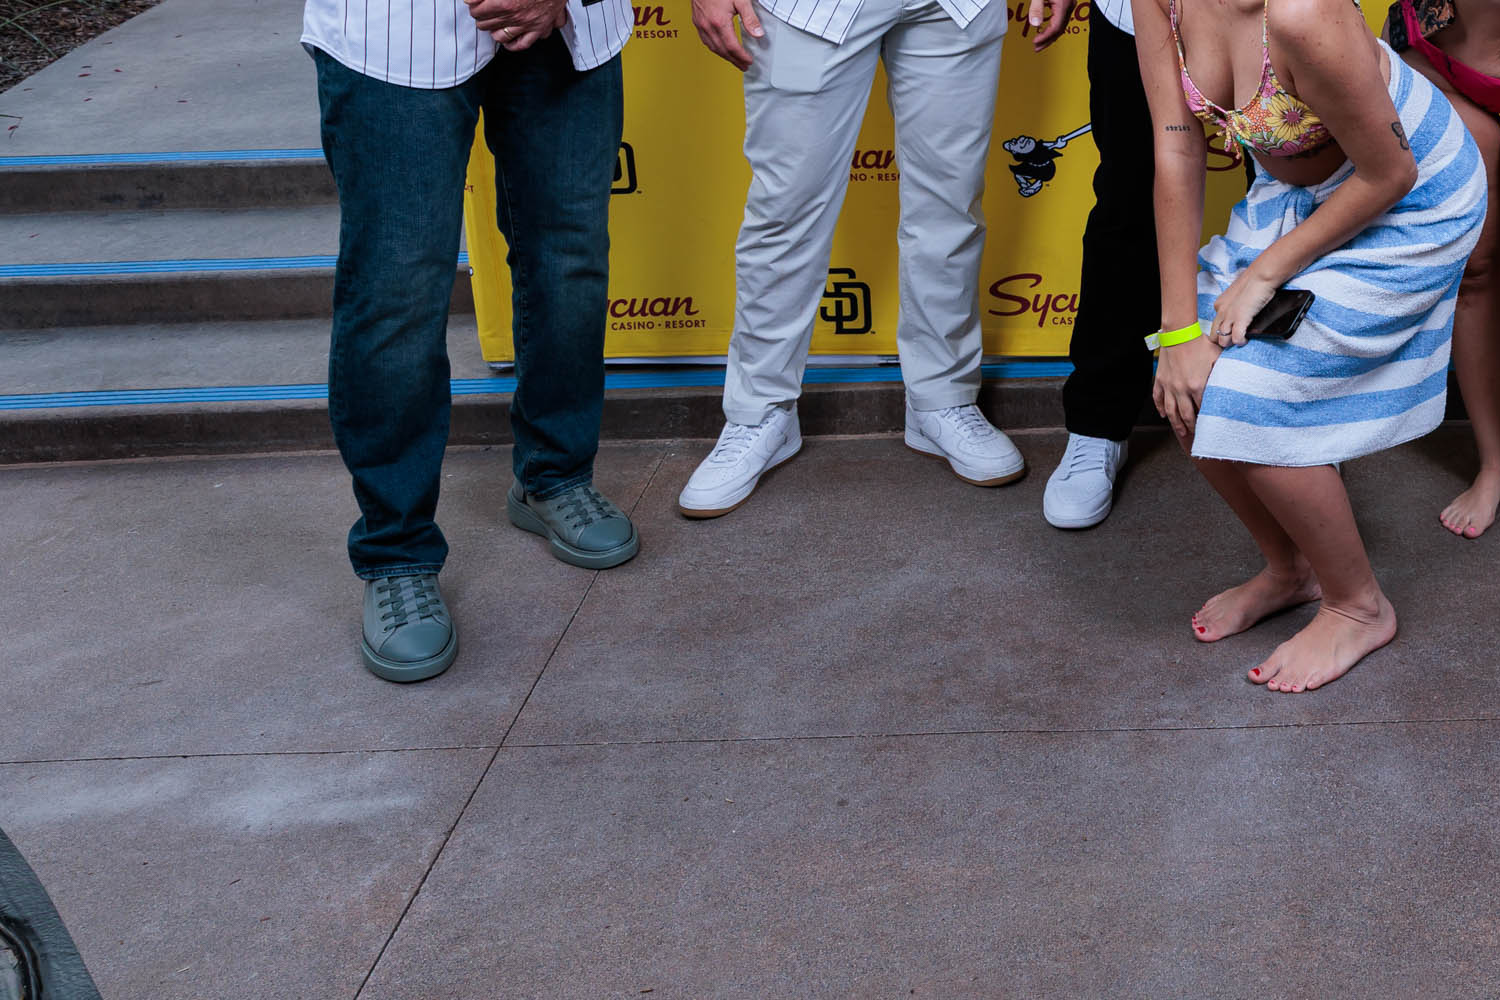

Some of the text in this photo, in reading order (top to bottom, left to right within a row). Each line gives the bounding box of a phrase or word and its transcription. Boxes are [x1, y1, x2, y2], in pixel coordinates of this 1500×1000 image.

[636, 30, 678, 39] RESORT
[877, 173, 900, 182] RES
[608, 296, 700, 319] cuan
[610, 319, 706, 331] CASINO RESORT
[1052, 316, 1073, 326] CAS
